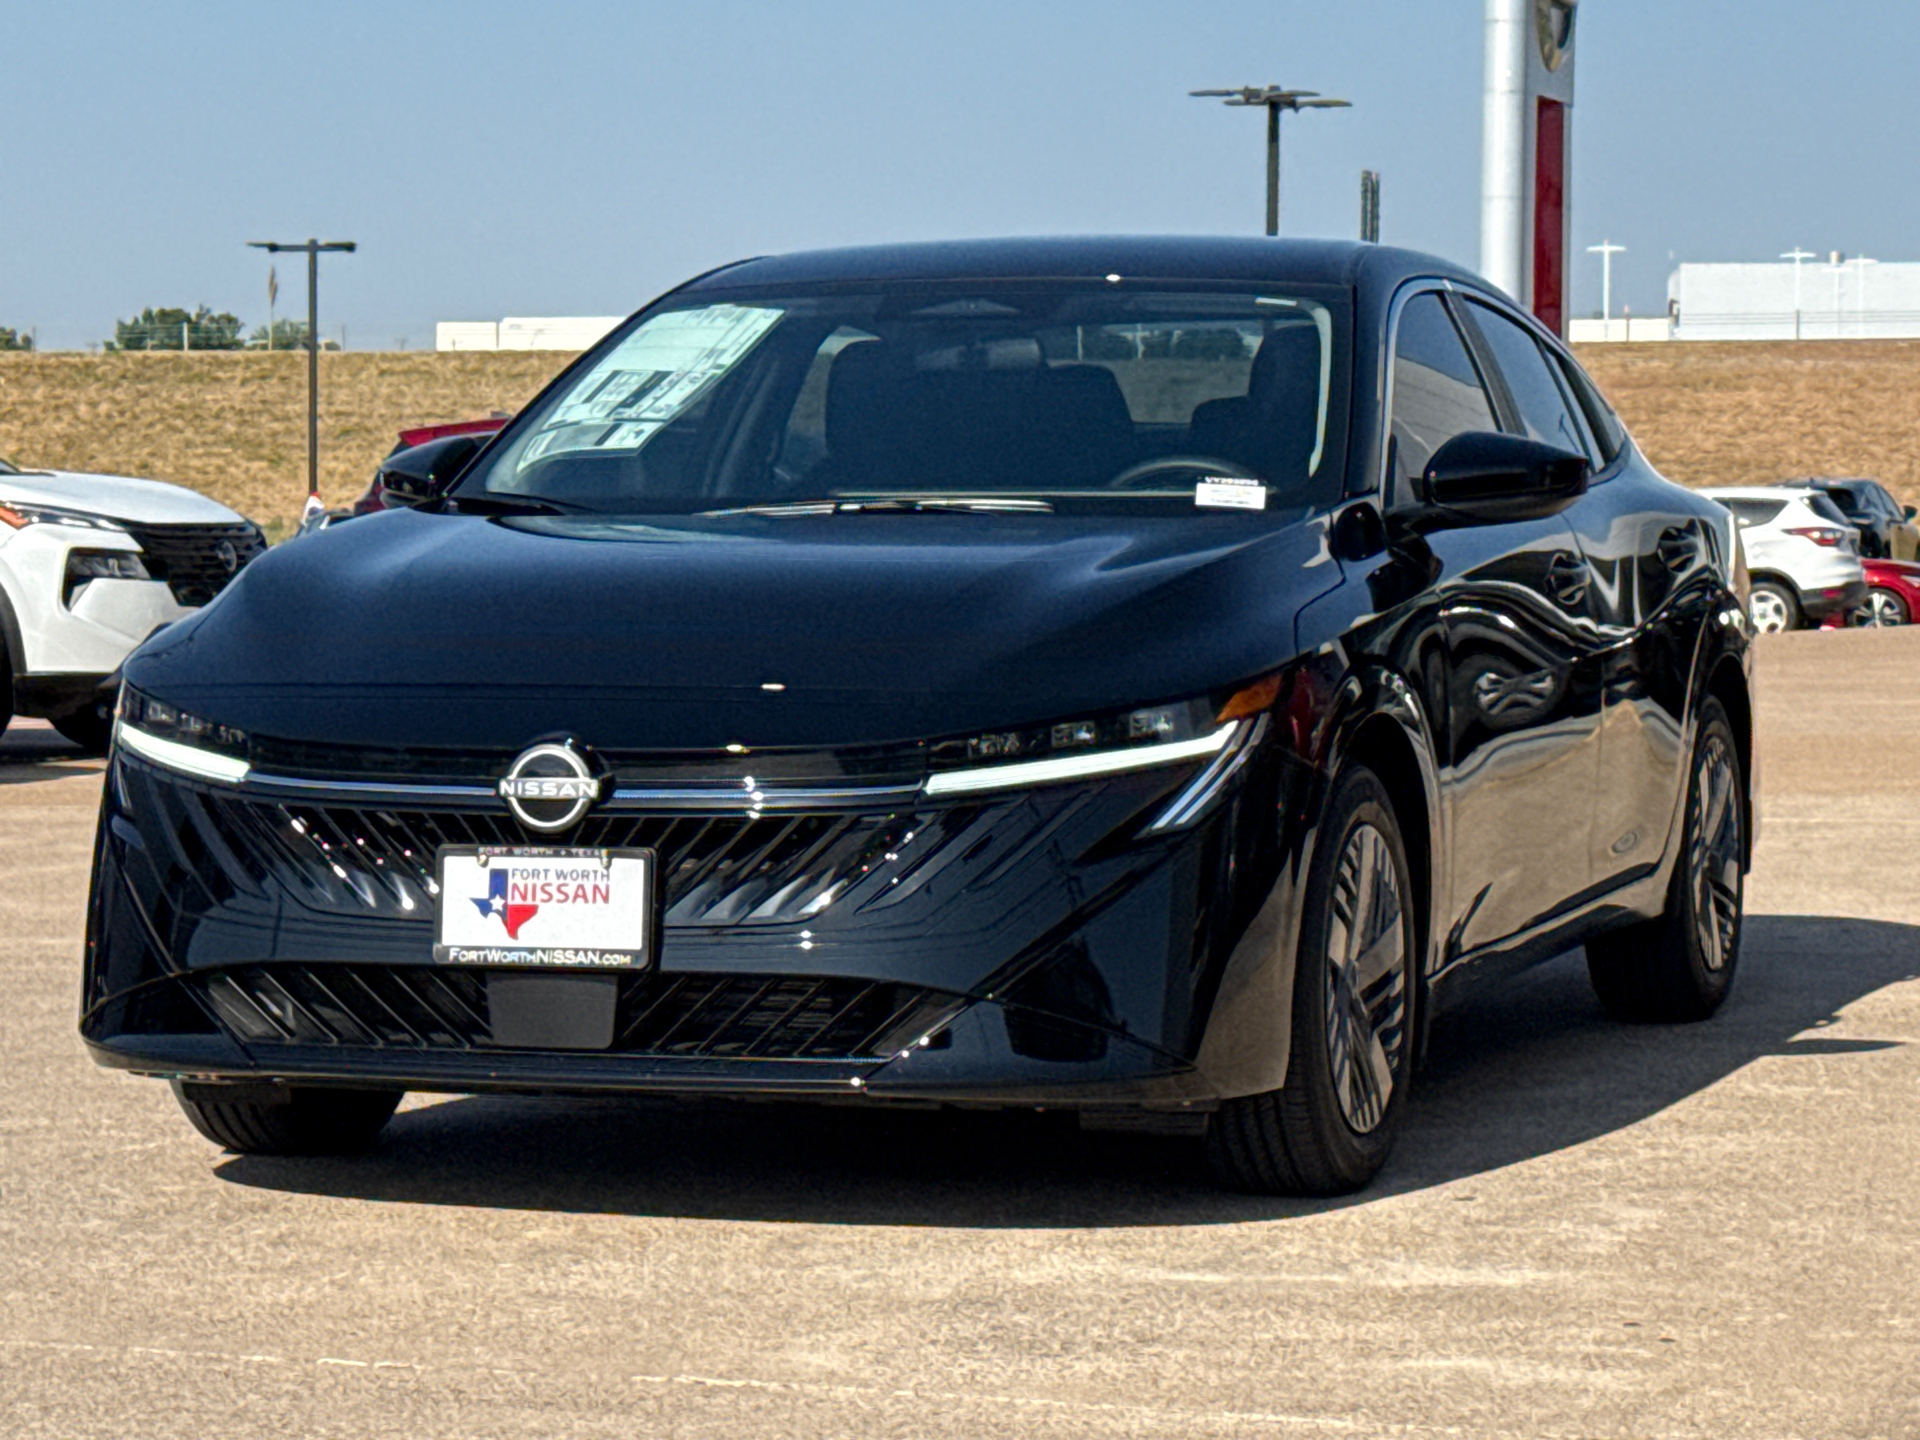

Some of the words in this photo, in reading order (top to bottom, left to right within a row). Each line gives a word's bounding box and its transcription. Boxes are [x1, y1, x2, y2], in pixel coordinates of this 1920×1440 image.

[500, 780, 597, 798] NISSAN
[511, 868, 551, 881] FORT
[555, 868, 611, 882] WORTH
[511, 882, 610, 905] NISSAN
